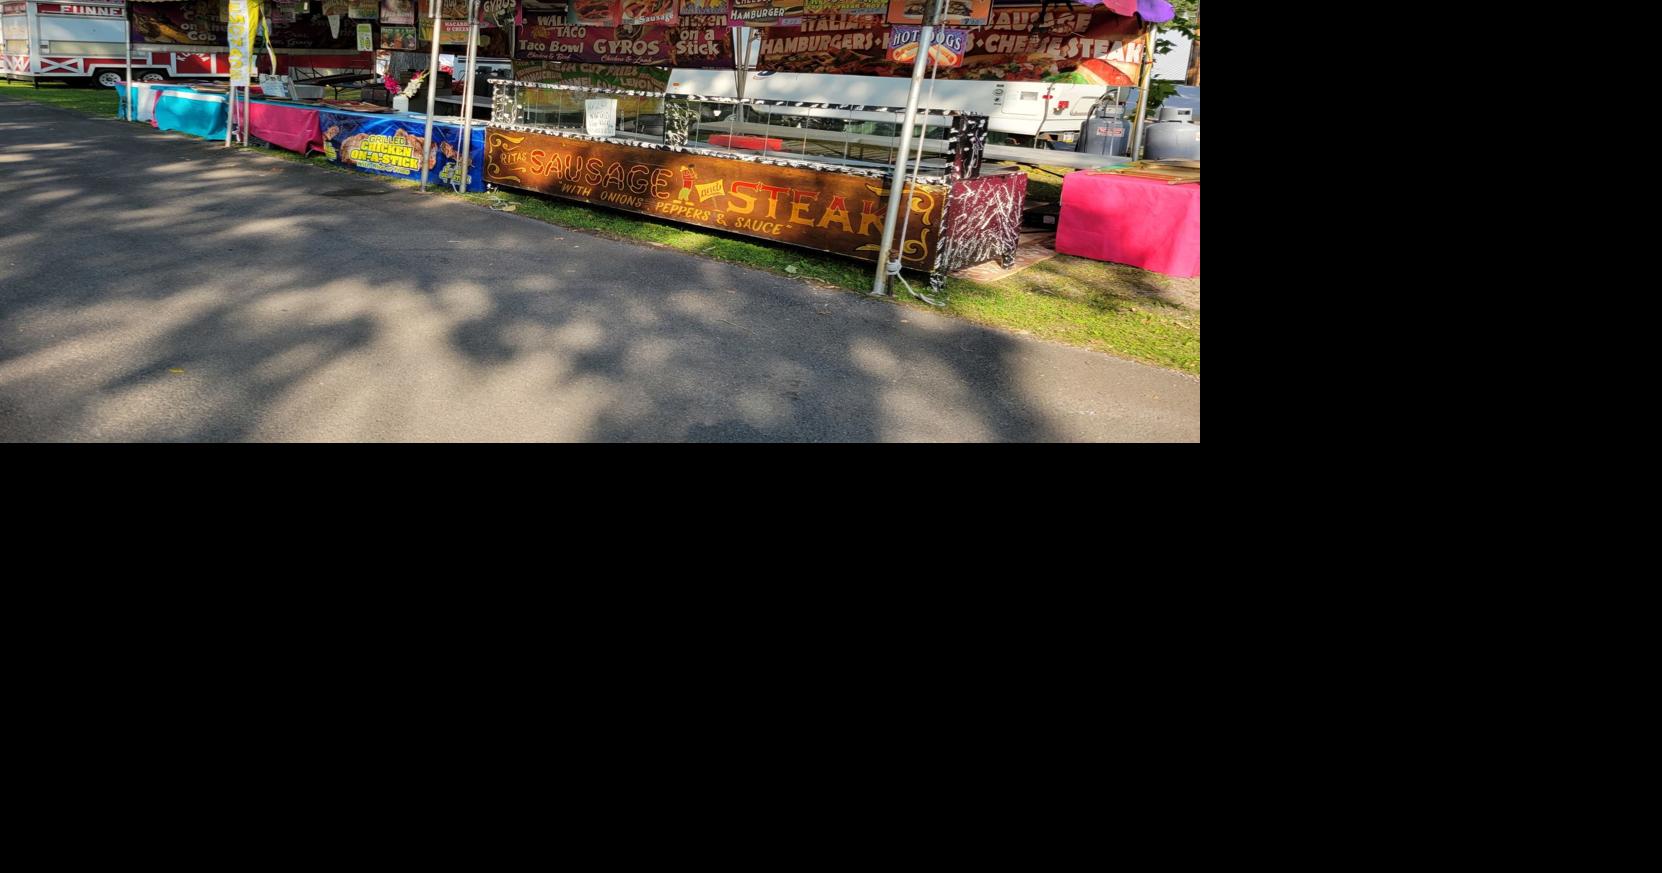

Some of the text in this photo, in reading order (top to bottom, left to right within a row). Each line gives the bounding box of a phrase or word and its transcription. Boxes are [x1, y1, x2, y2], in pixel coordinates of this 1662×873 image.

[731, 8, 785, 20] HAMBURGER
[187, 31, 216, 41] Cob
[547, 26, 586, 38] TACO
[680, 29, 714, 40] on a
[893, 30, 920, 46] HOT
[519, 40, 584, 53] Taco Bowl
[593, 39, 660, 55] GYROS
[676, 41, 720, 55] Stick
[760, 32, 873, 55] HAMBURGERS
[369, 135, 405, 145] GRILLED
[360, 140, 412, 157] CHICKEN
[530, 149, 673, 199] SAUSAGE
[726, 180, 886, 236] STEAK
[655, 201, 711, 222] PEPPERS
[715, 212, 727, 226] &
